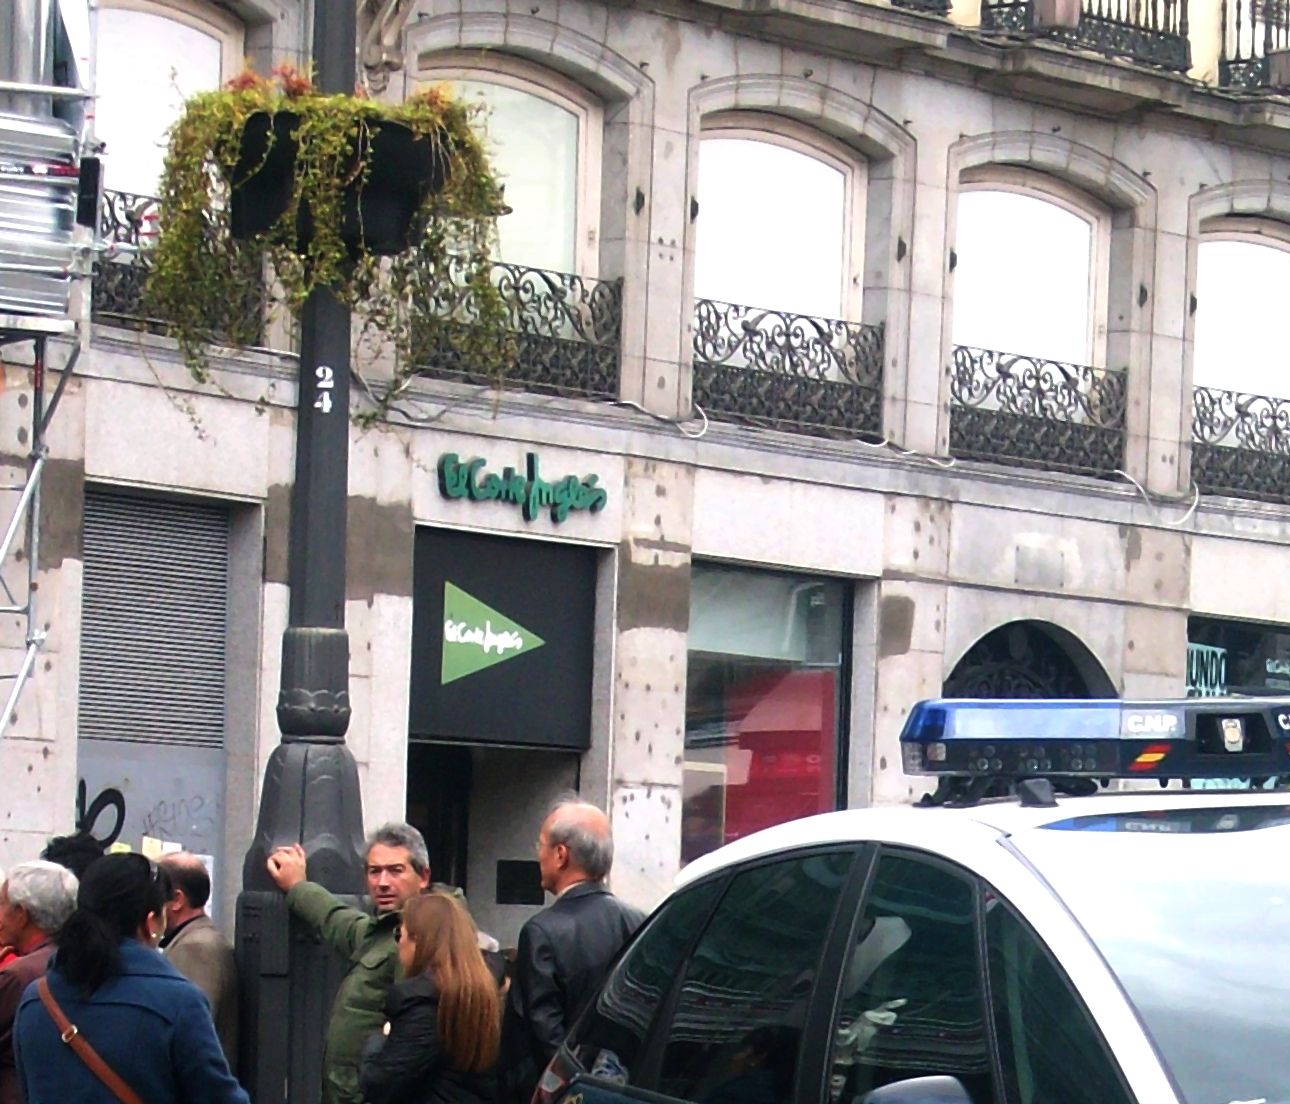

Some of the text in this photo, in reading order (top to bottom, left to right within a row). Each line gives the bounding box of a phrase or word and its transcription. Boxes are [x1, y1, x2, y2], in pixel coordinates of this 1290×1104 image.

[437, 452, 607, 523] El Corte Inglés
